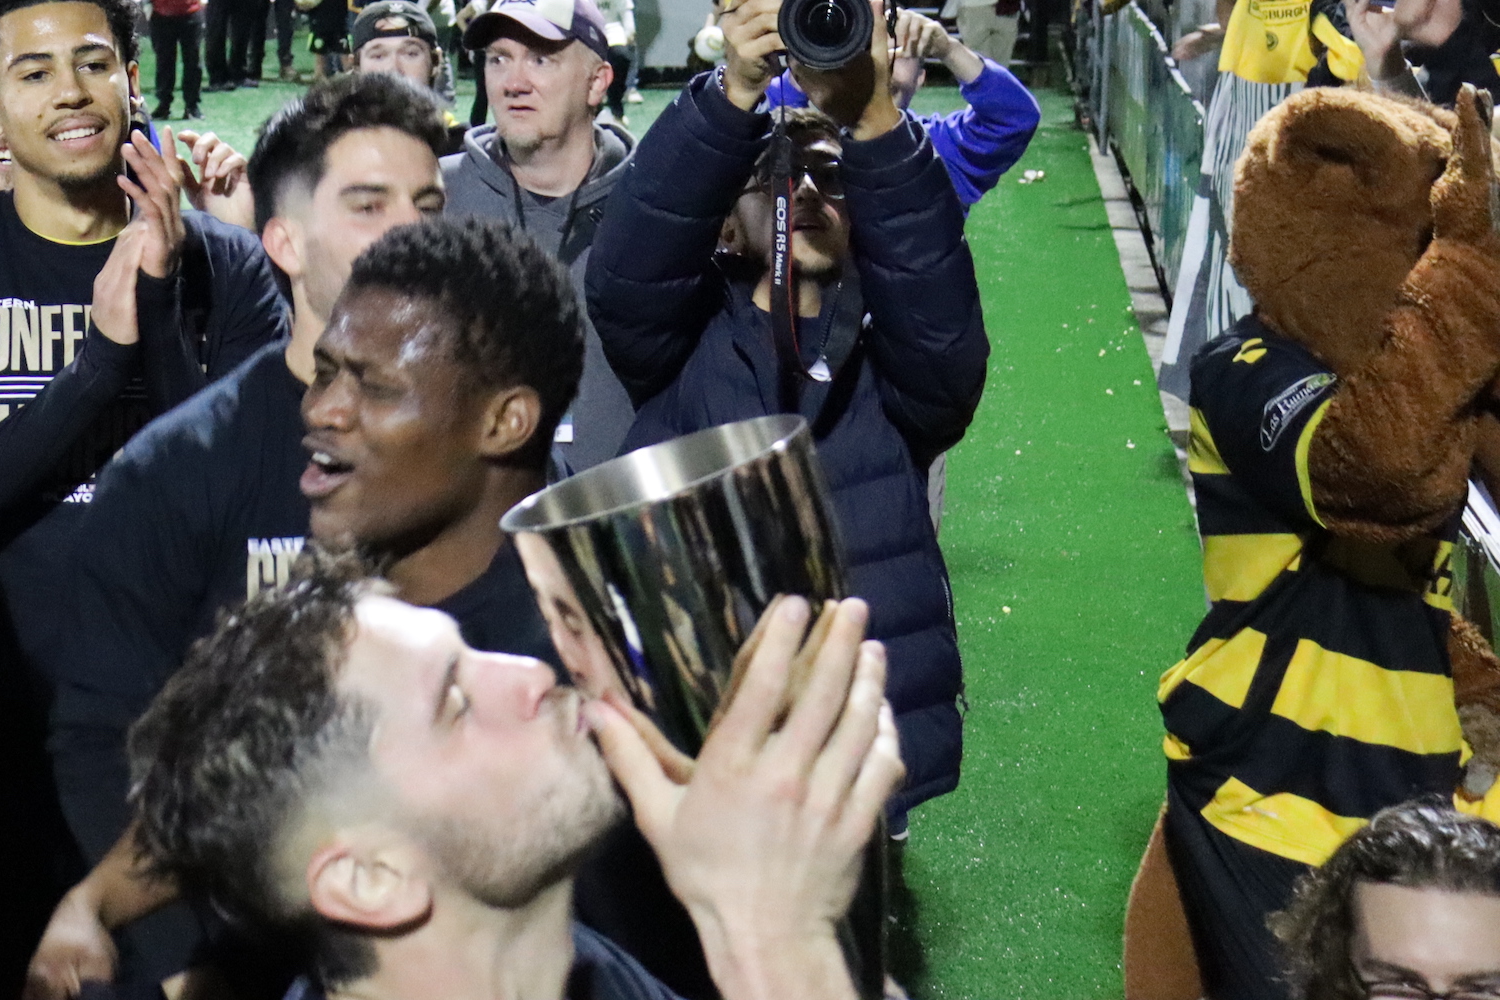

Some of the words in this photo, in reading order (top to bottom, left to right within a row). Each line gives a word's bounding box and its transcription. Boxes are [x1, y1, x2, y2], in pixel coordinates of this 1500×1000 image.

[776, 196, 787, 232] EOS
[776, 233, 787, 252] R5
[774, 252, 784, 277] Mark
